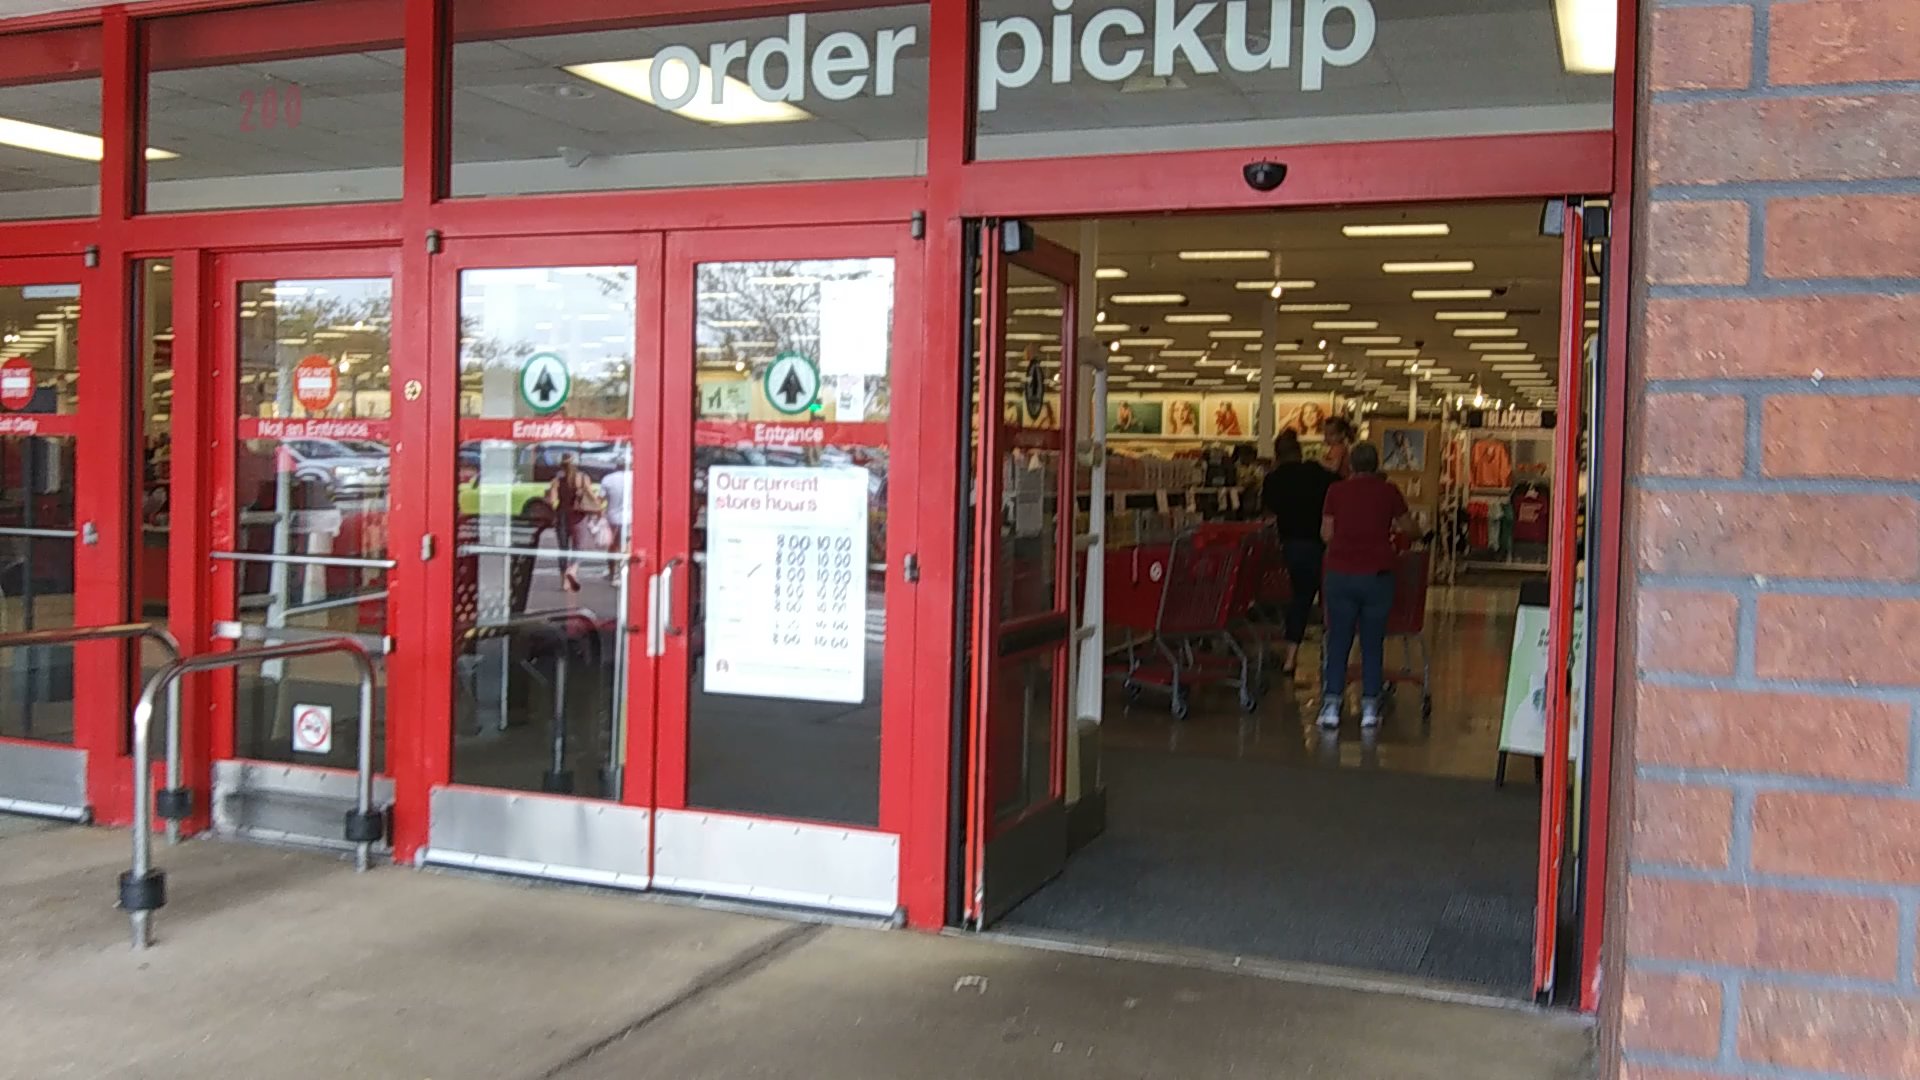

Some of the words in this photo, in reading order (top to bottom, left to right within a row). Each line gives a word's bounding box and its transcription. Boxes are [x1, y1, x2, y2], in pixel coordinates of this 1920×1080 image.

[649, 13, 916, 109] order
[978, 0, 1376, 111] pickup
[240, 84, 302, 132] 200
[258, 420, 283, 436] Not
[286, 424, 303, 437] an
[306, 420, 368, 437] Entrance
[513, 420, 575, 438] Entrance
[753, 424, 824, 442] Entrance
[717, 473, 751, 490] Our
[753, 477, 818, 491] current
[715, 494, 760, 510] store
[765, 493, 817, 511] hours
